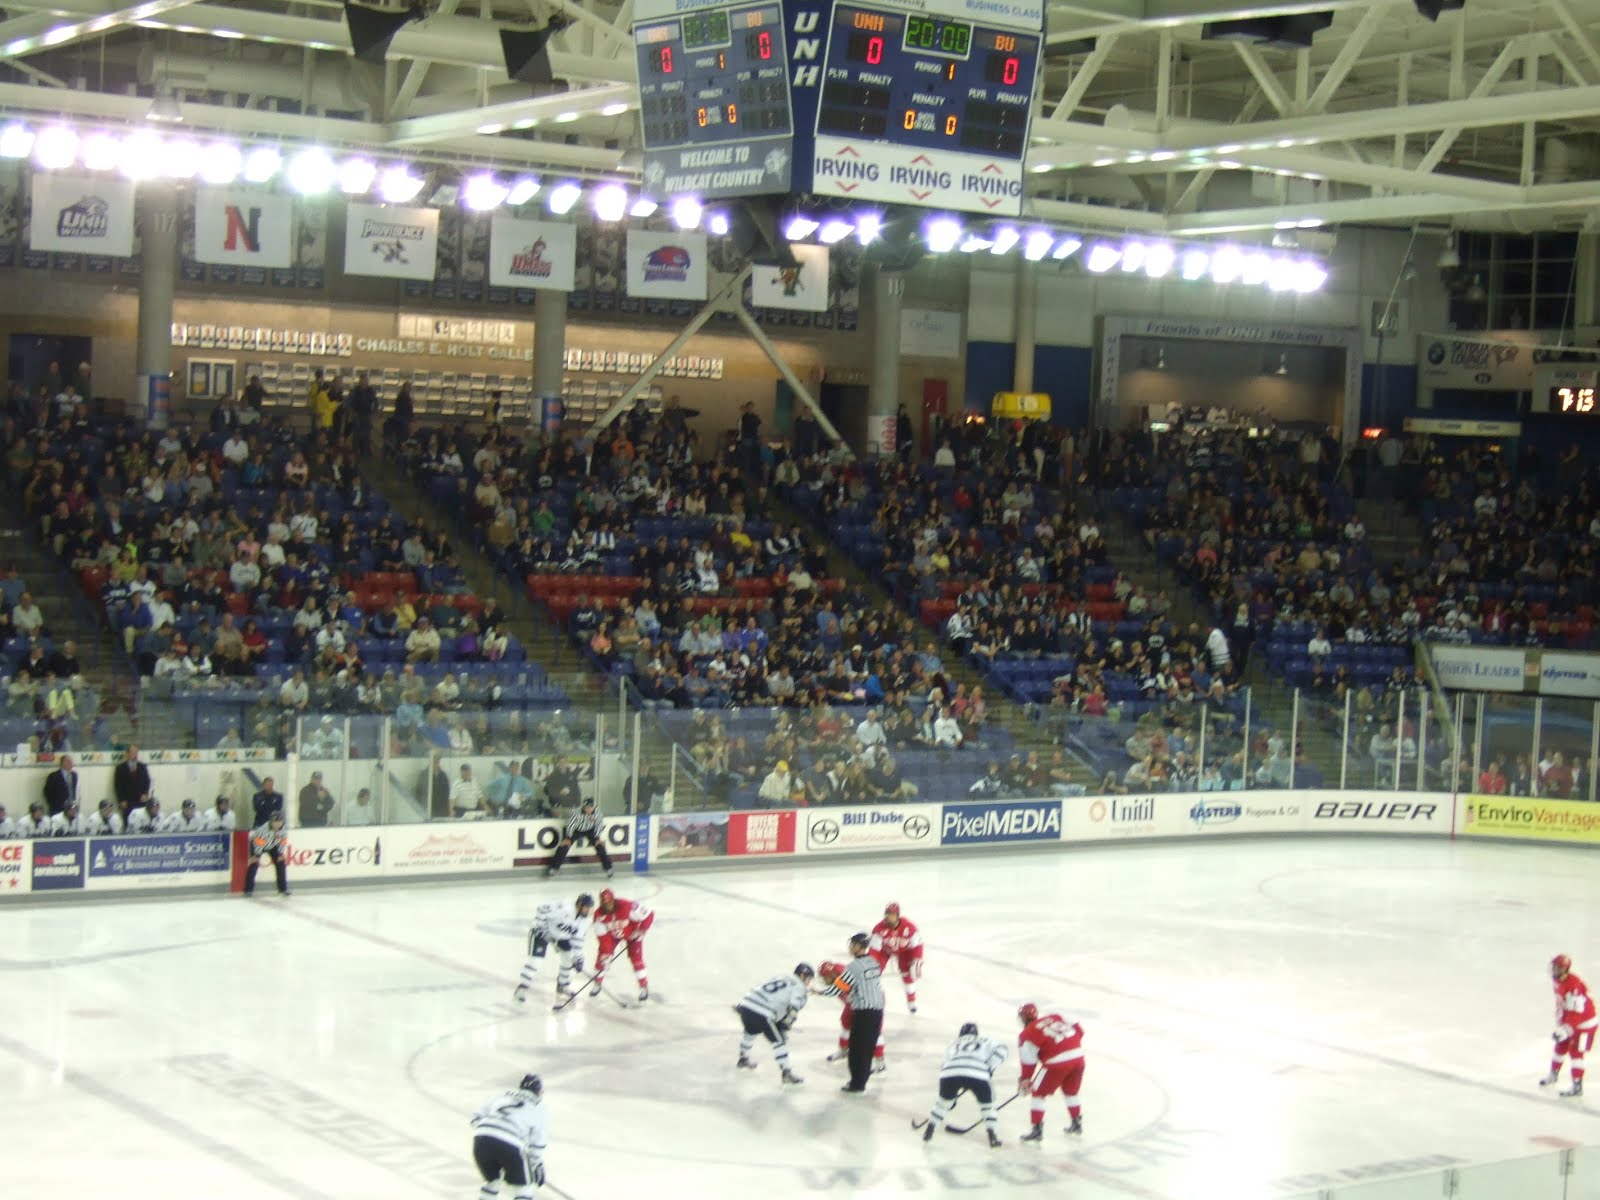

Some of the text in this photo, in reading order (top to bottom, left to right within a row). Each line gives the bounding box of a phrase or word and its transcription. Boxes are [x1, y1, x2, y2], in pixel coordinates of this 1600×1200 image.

[966, 0, 1009, 14] BUSINESS
[854, 12, 884, 32] UNH
[758, 31, 772, 60] 0
[906, 20, 969, 53] 20:00
[994, 35, 1016, 52] BU
[660, 46, 673, 74] 0
[718, 52, 726, 70] 1
[866, 36, 884, 65] 0
[858, 72, 893, 86] PENALTY
[948, 63, 956, 81] 1
[1003, 57, 1019, 85] 0
[697, 107, 709, 128] 0
[727, 103, 738, 125] 0
[903, 109, 916, 130] 0
[945, 115, 957, 136] 0
[679, 146, 750, 169] WELCOME TO
[664, 168, 765, 193] WILDCAT COUNTRY
[815, 157, 1022, 197] IRVING IRVING IRVING
[223, 205, 261, 253] N
[356, 338, 426, 354] CHARLES
[447, 346, 483, 357] HOLT
[487, 348, 534, 361] GALLE
[842, 812, 867, 826] Bill
[1111, 798, 1155, 822] Unitil
[1189, 803, 1242, 820] EASTERN
[942, 807, 1060, 838] PixelMEDIA
[112, 844, 181, 857] WHITTEMORE
[762, 978, 788, 995] 8
